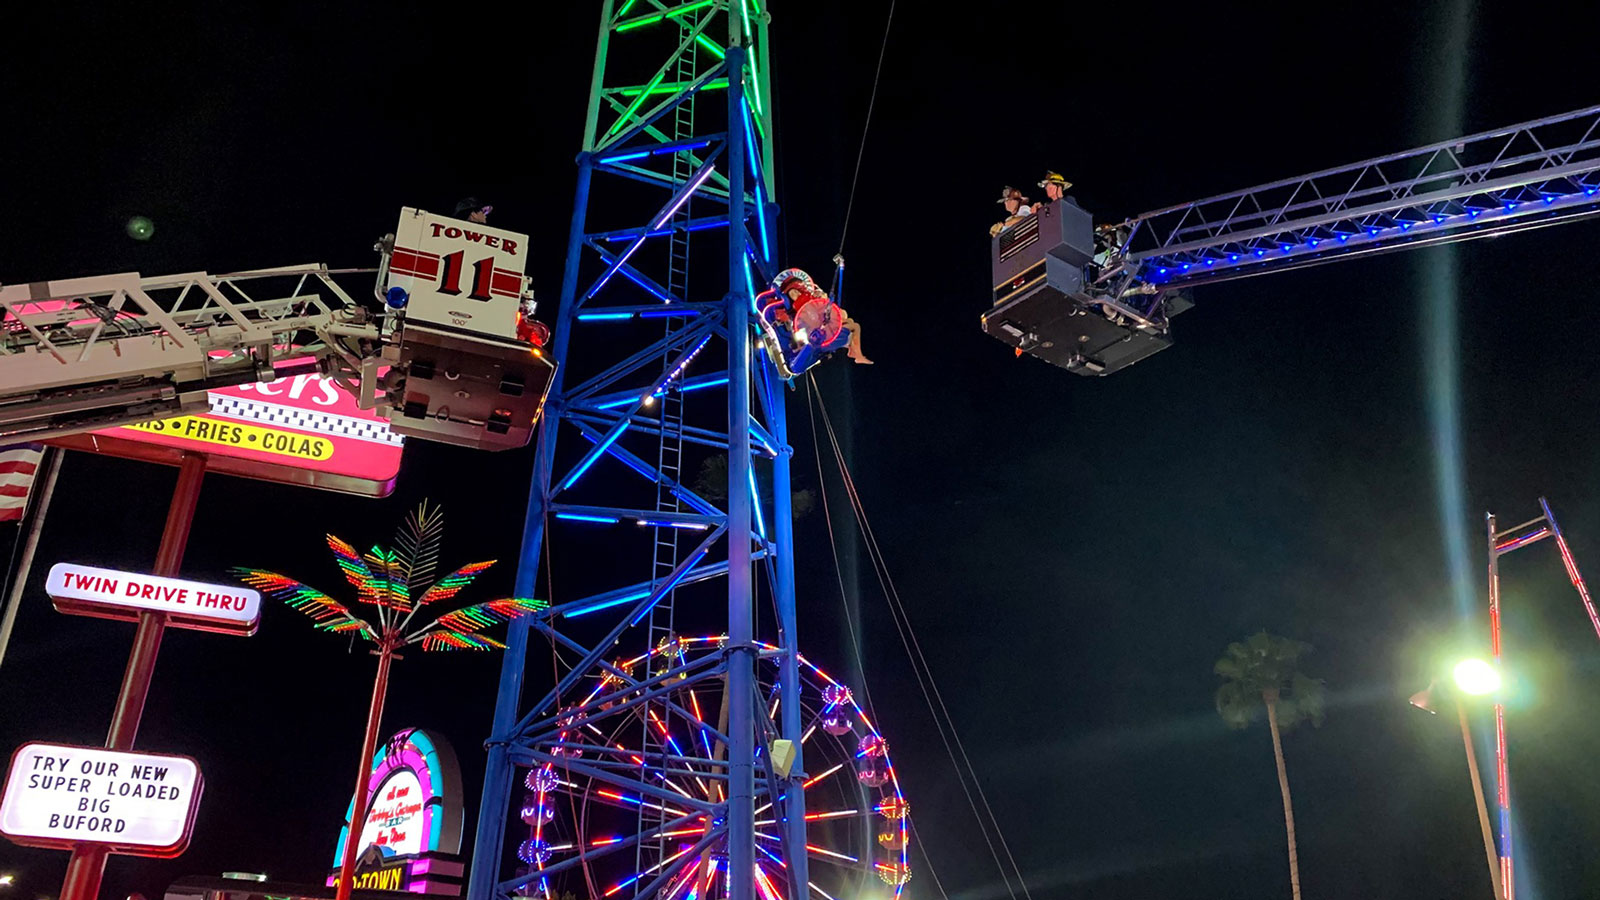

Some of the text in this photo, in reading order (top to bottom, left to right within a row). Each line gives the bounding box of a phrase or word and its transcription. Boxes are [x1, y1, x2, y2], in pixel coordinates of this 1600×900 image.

[430, 223, 518, 256] TOWER
[436, 250, 495, 303] 11
[185, 419, 243, 444] FRIES
[262, 432, 324, 457] COLAS
[63, 572, 247, 611] TWIN DRIVE THRU
[33, 756, 168, 781] TRY OUR NEW
[28, 774, 180, 800] SUPER LOADED
[78, 797, 110, 813] BIG
[48, 813, 126, 833] BUFORD
